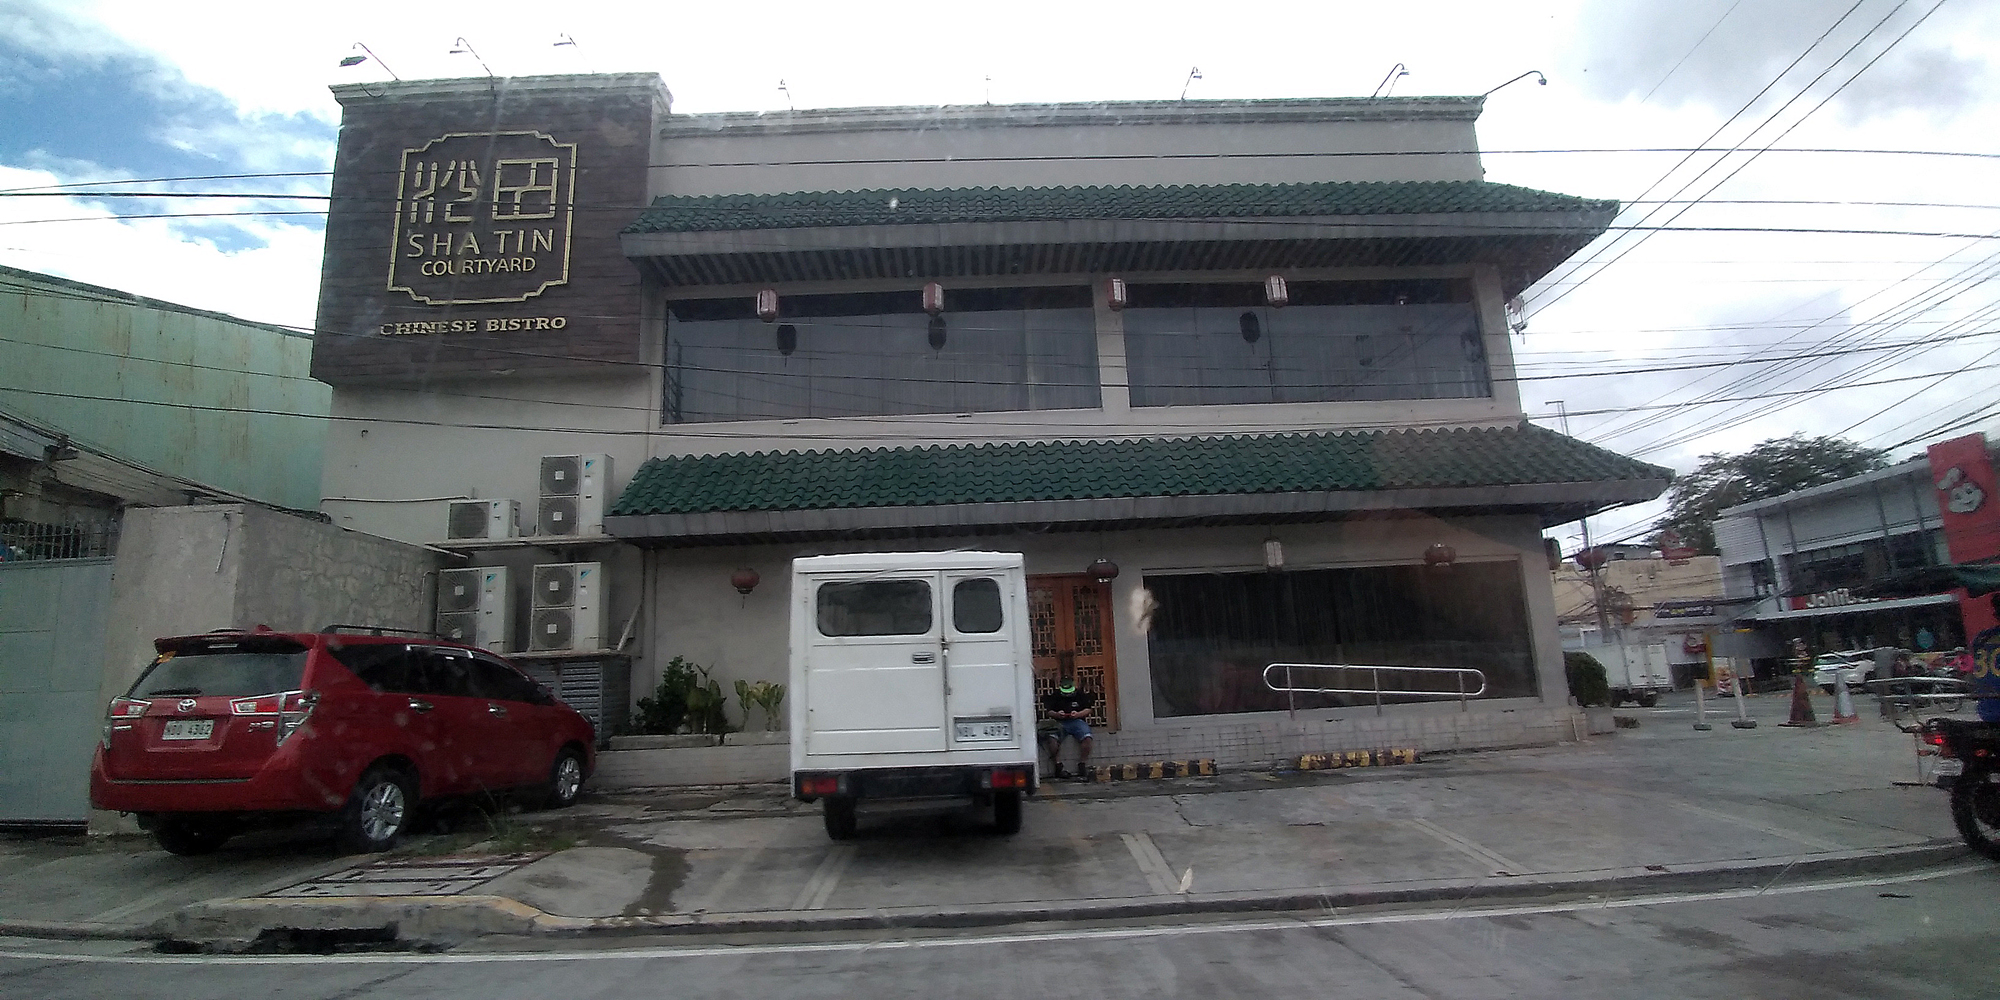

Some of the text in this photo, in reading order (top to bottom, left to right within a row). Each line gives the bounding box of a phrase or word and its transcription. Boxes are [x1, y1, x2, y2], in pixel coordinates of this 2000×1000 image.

[406, 229, 553, 258] SHA TIN
[421, 257, 536, 276] COURTYARD
[380, 317, 567, 335] CHINESE BISTRO
[1805, 587, 1880, 608] Jollib
